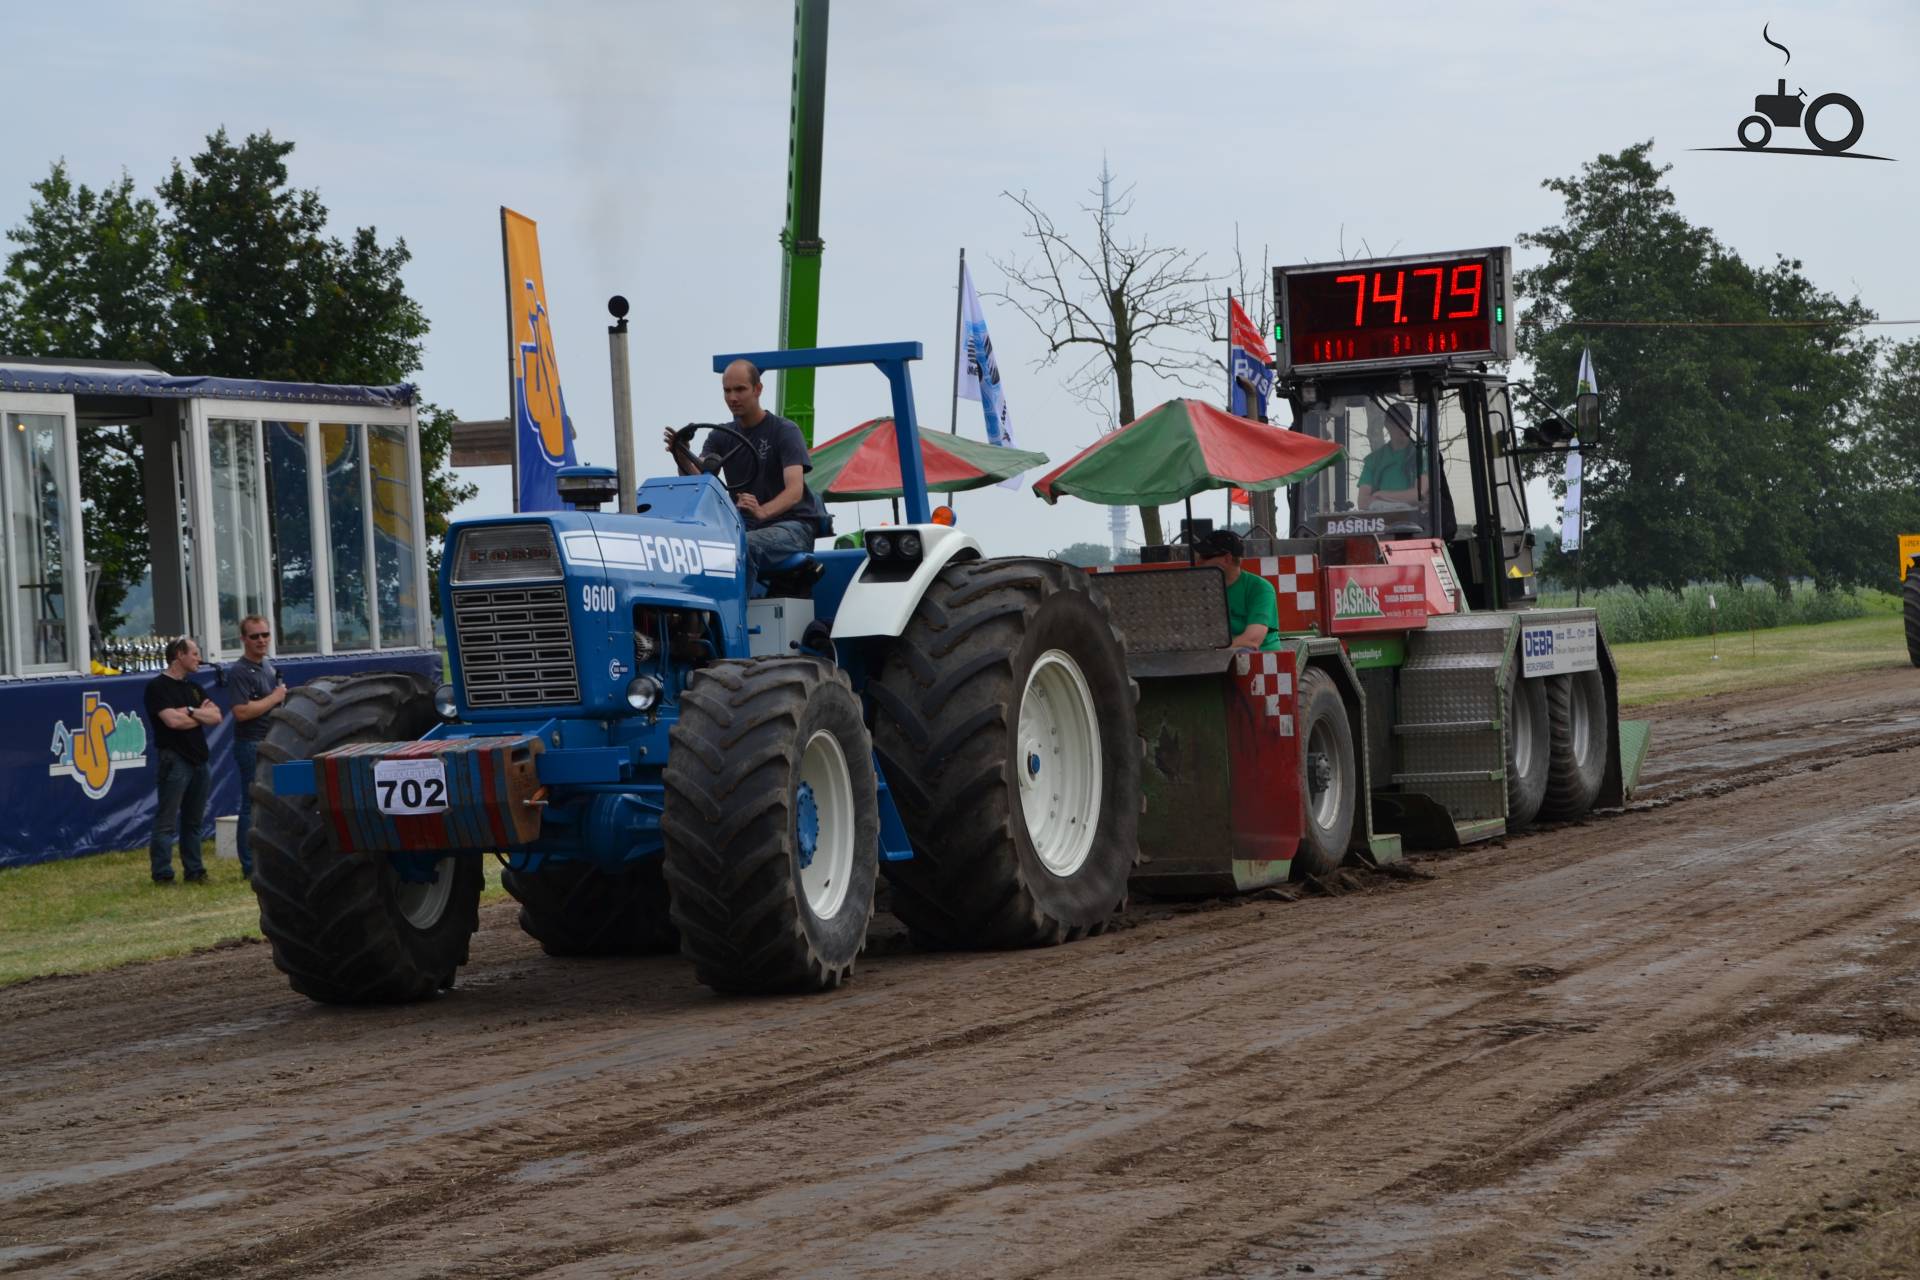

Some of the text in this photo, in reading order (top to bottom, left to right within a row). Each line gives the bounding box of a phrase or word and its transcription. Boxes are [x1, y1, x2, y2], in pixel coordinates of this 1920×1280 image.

[1336, 264, 1483, 327] 74.79
[1327, 517, 1385, 535] BASRIJS
[639, 535, 702, 575] FORD
[583, 585, 615, 613] 9600
[1334, 586, 1380, 615] BASRIJS
[1525, 630, 1553, 657] DEBA
[377, 778, 447, 809] 702
